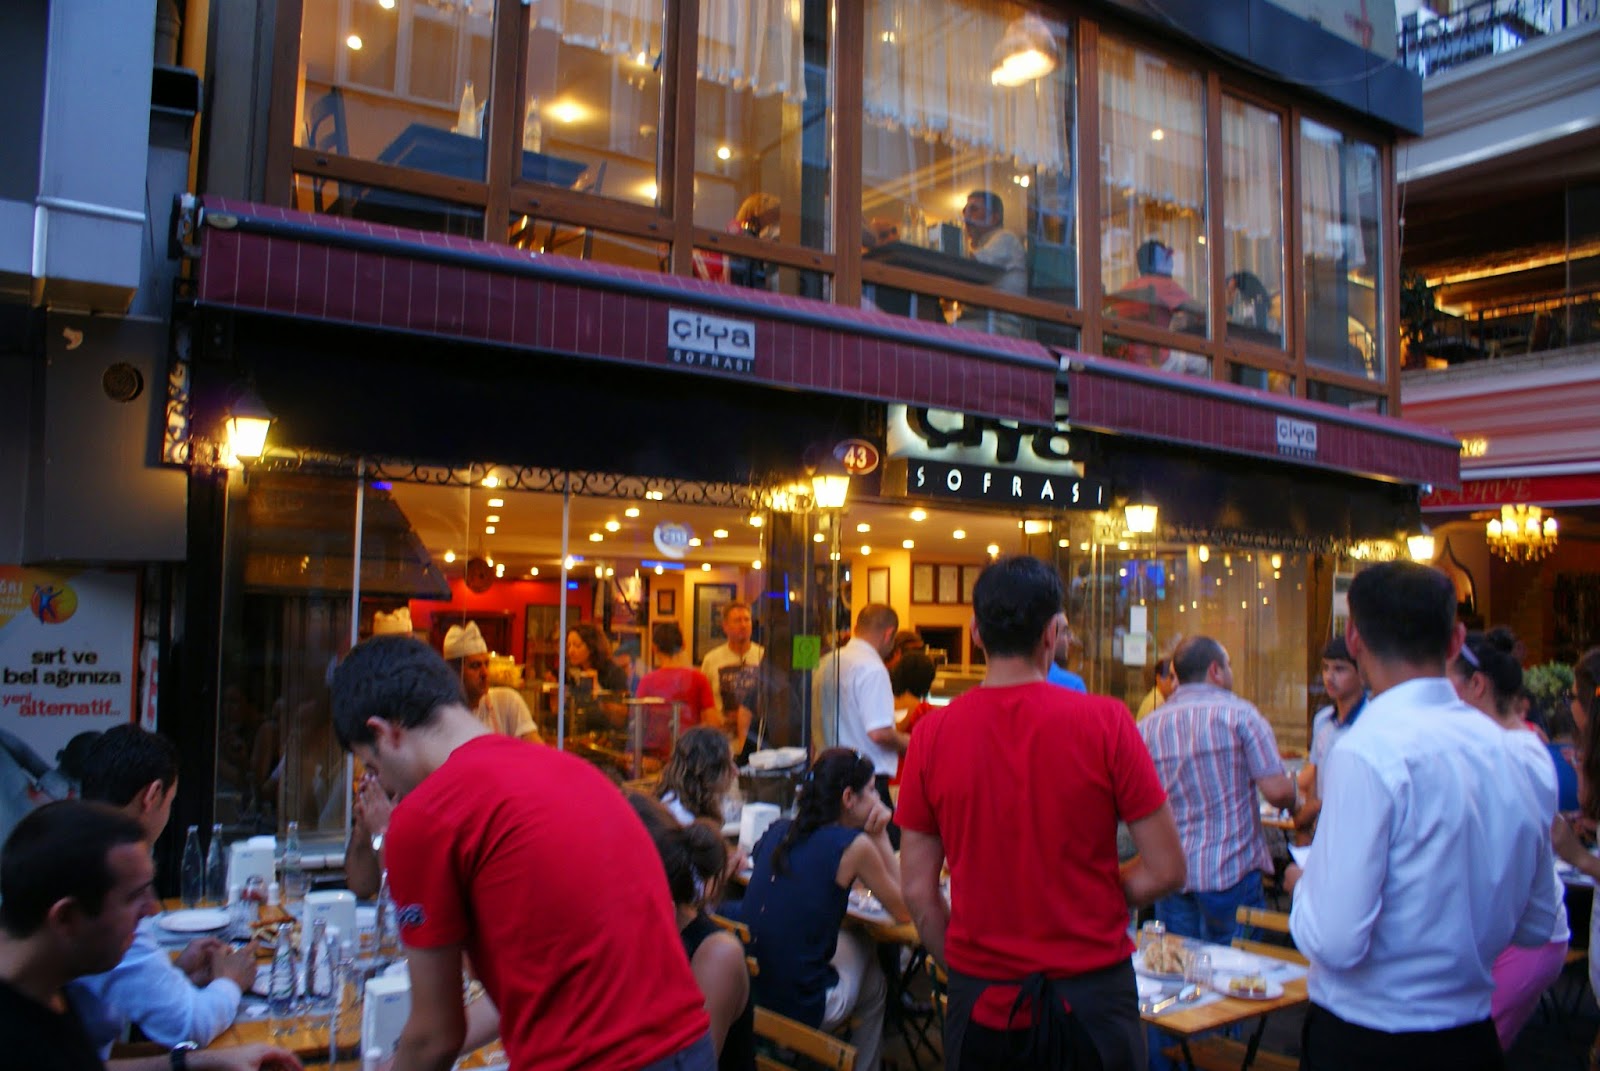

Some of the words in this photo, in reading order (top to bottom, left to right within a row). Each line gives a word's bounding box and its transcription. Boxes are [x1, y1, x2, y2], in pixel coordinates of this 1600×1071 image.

[844, 445, 867, 468] 43
[917, 465, 1104, 505] SOFRASI
[31, 648, 66, 665] sırt
[72, 651, 98, 665] ve
[3, 668, 37, 685] bel
[43, 668, 121, 688] ağrınıza
